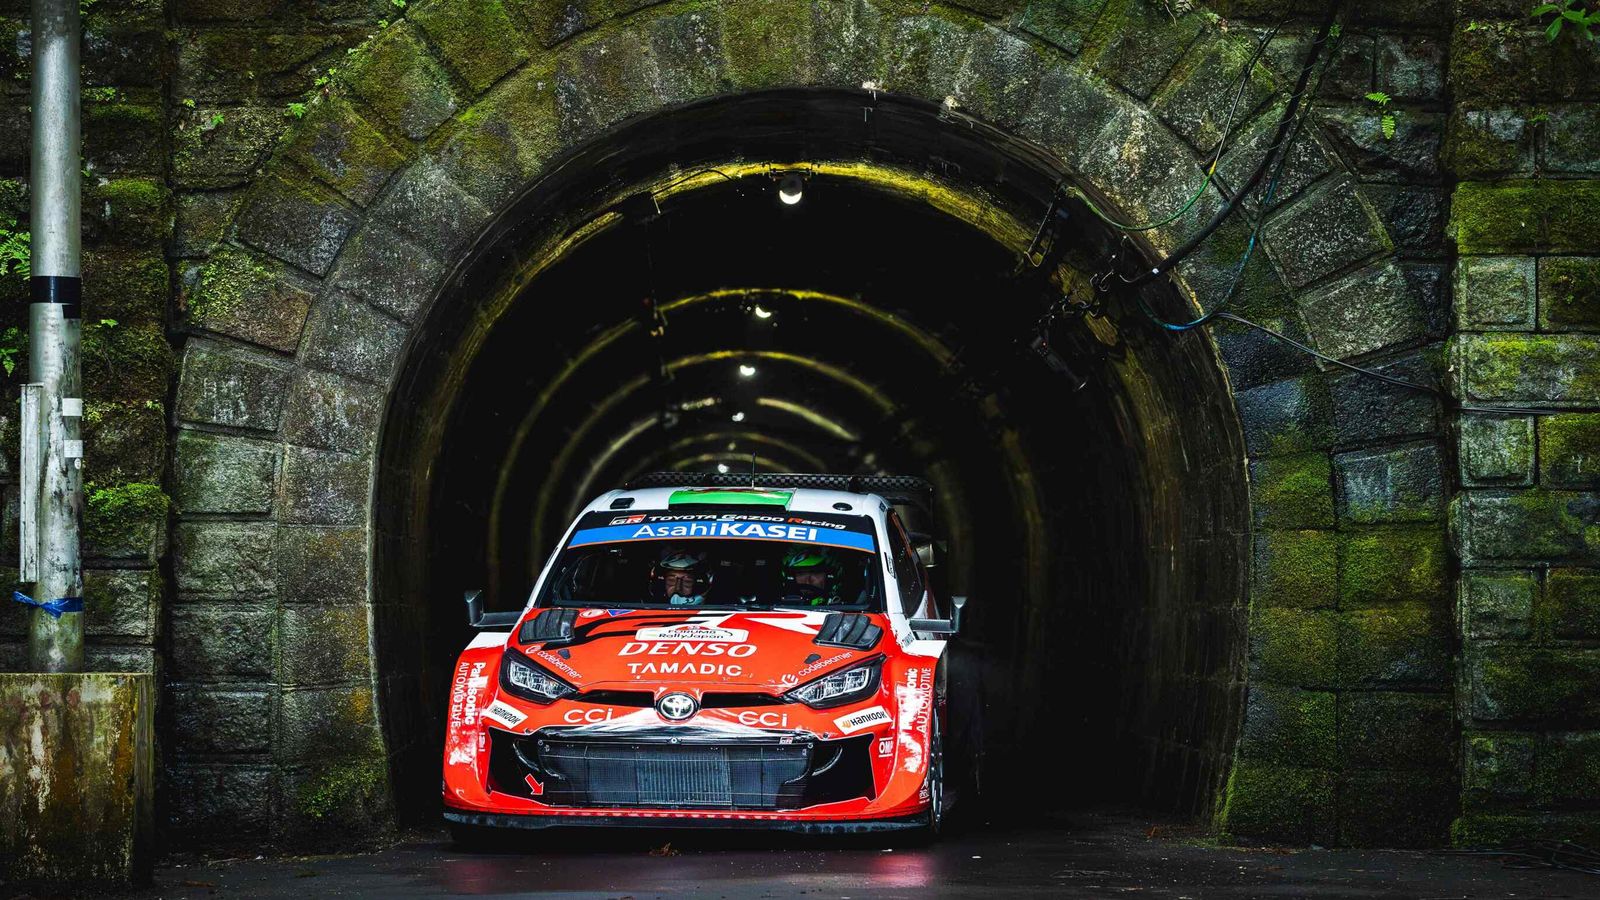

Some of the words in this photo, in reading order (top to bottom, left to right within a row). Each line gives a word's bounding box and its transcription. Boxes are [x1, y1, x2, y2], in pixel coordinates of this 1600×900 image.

[649, 514, 717, 522] TOYOTA
[717, 514, 785, 522] GAZOO
[787, 517, 846, 530] Racing
[617, 641, 758, 658] DENSO
[627, 662, 743, 677] TAMADIC
[798, 652, 853, 677] codebeamer
[563, 708, 613, 724] CCi
